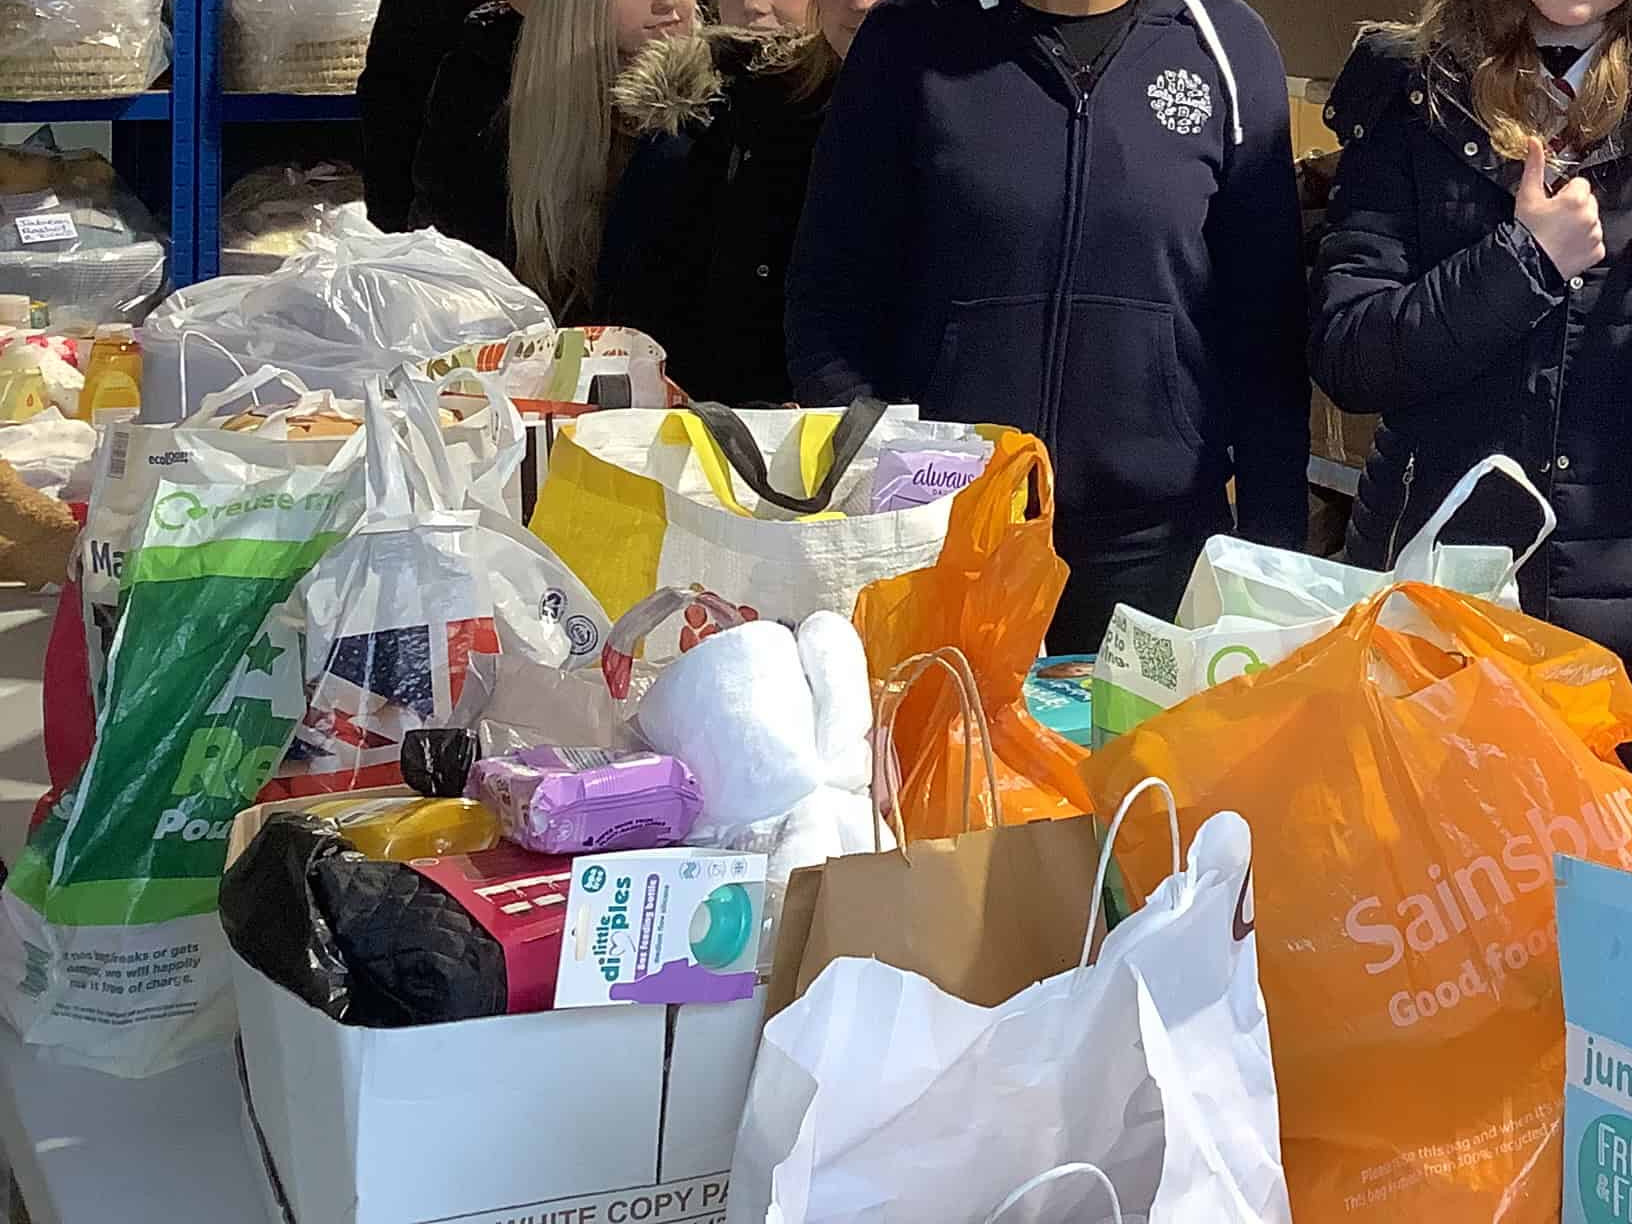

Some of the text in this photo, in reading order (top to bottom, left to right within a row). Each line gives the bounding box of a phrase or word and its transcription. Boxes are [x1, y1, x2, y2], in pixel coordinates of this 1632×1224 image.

[1388, 928, 1556, 1027] Good foo
[606, 1187, 694, 1224] COPY
